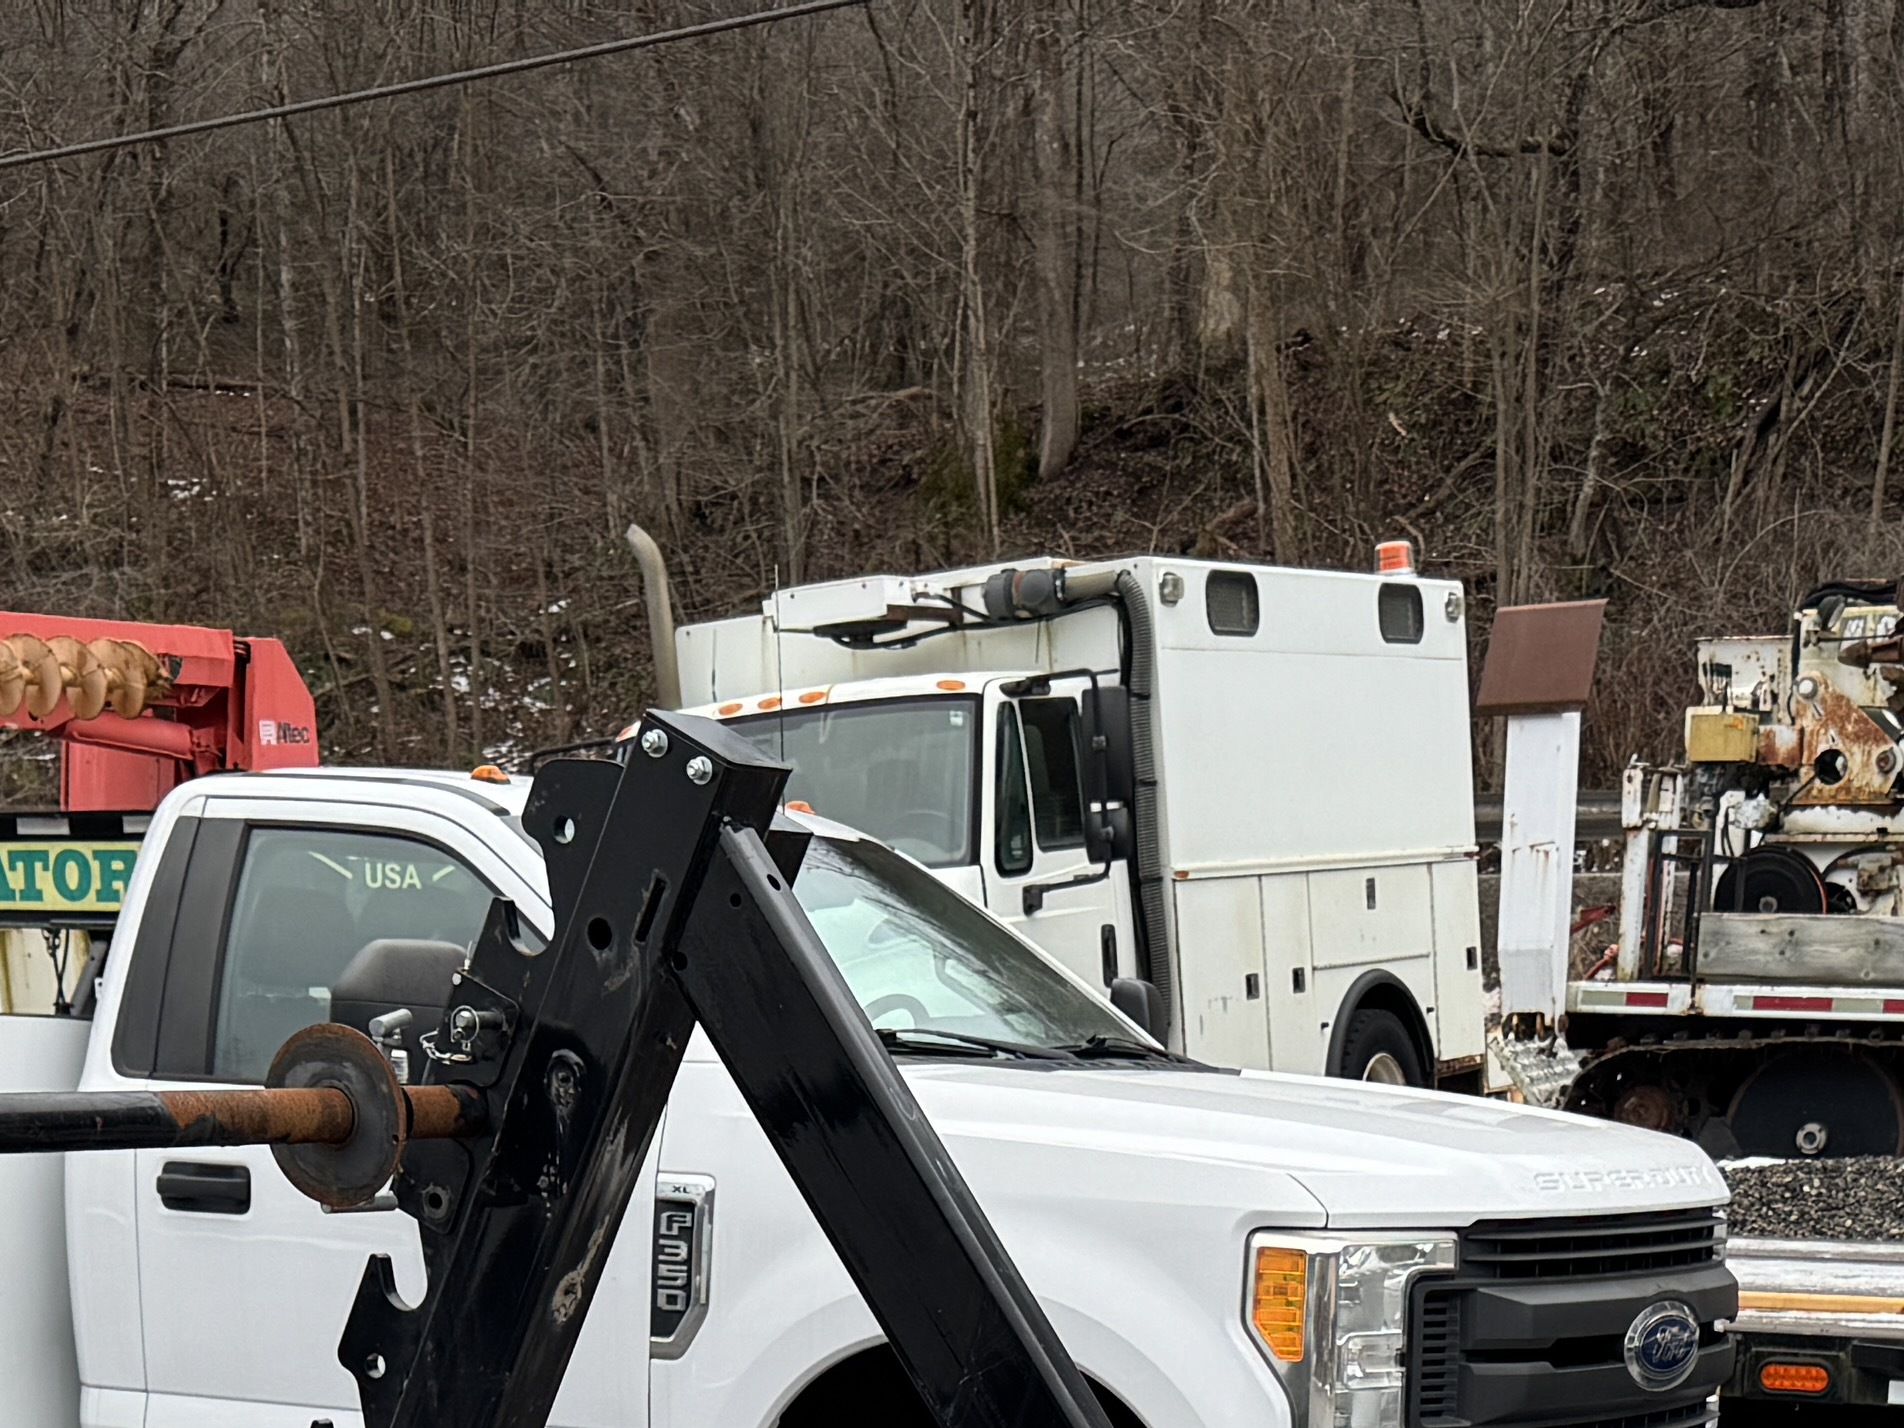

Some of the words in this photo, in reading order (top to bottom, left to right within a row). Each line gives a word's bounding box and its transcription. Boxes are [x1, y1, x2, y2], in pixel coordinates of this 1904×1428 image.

[364, 862, 422, 890] USA
[672, 1185, 690, 1194] XL
[656, 1211, 693, 1312] F350
[1645, 1325, 1694, 1364] Ford
